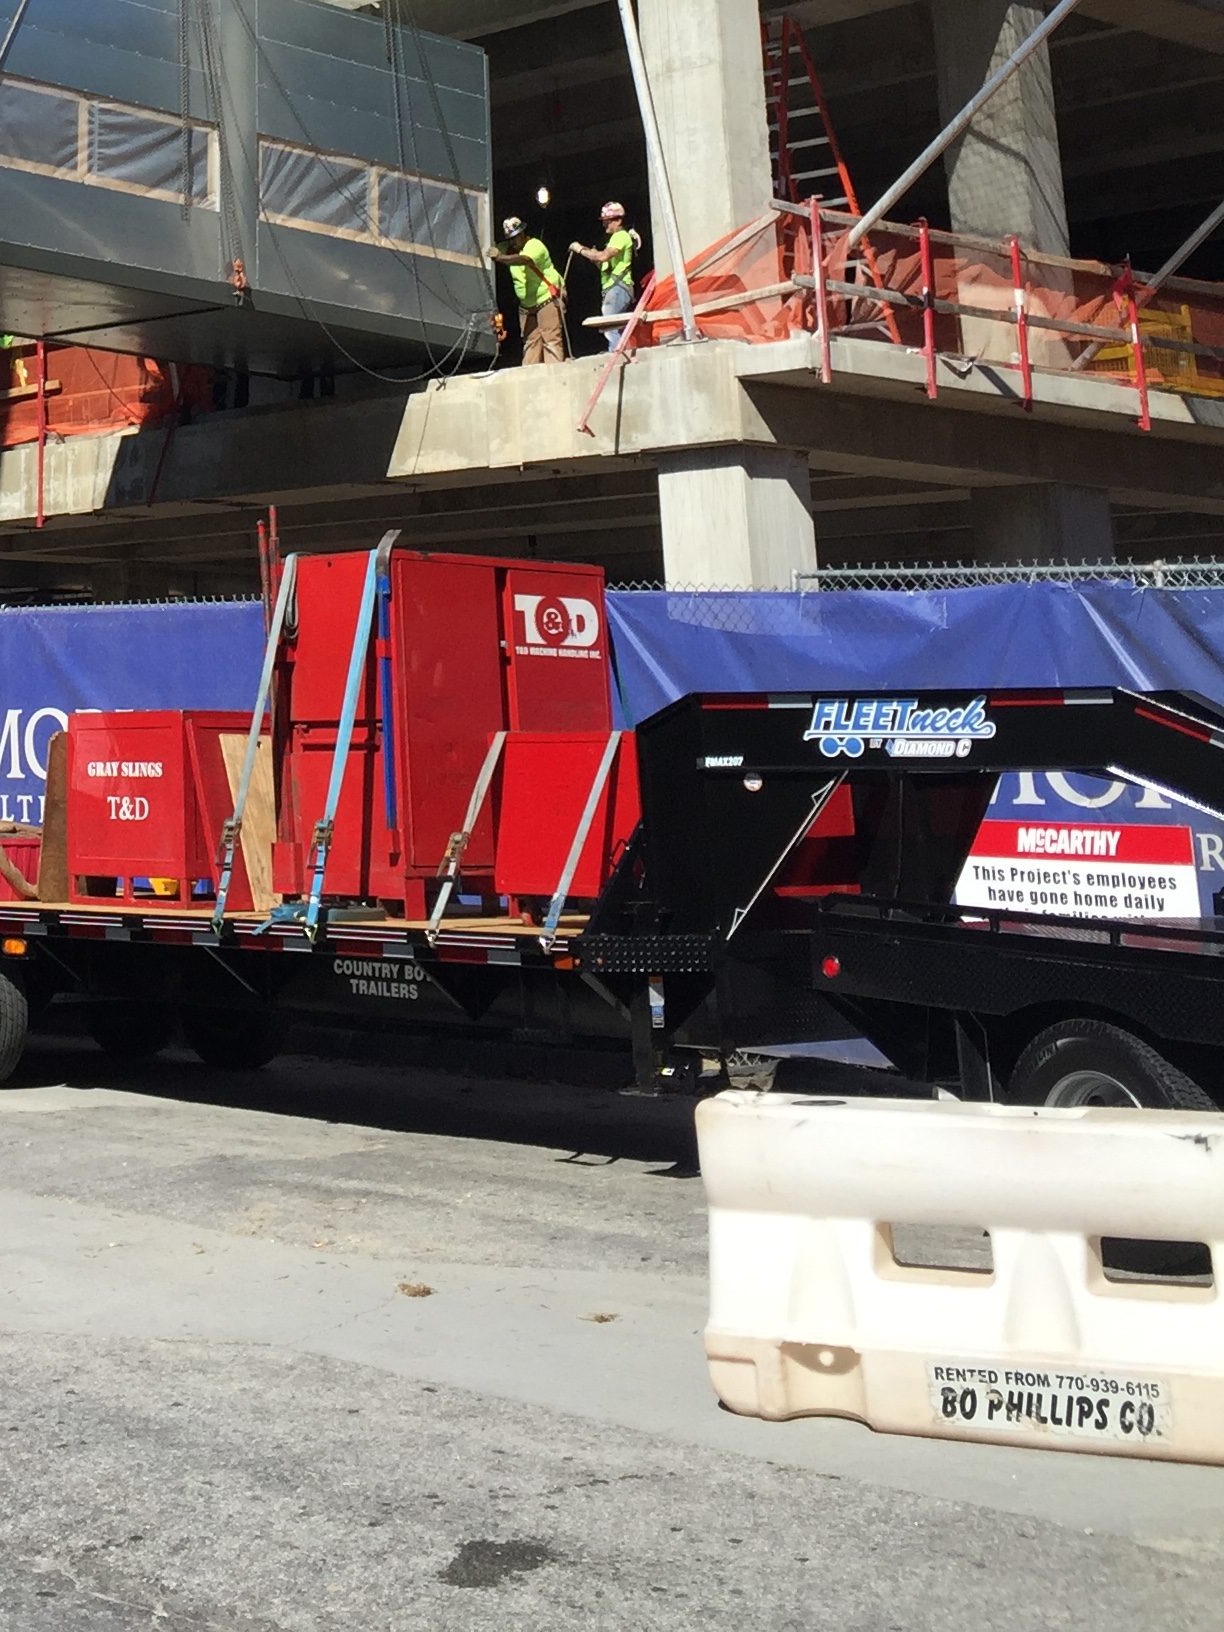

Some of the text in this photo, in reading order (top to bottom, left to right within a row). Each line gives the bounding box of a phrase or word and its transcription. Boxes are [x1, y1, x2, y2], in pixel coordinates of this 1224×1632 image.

[513, 593, 599, 647] T&D
[956, 739, 972, 757] C
[87, 760, 163, 778] GRAY SLINGS
[107, 795, 149, 821] T&D
[973, 865, 1178, 891] This Project's employees
[988, 886, 1025, 903] have
[1029, 890, 1069, 906] gone
[1073, 890, 1119, 909] home
[1123, 893, 1166, 913] daily
[333, 959, 401, 979] COUNTRY
[349, 978, 419, 1000] TRAILERS
[934, 1367, 1160, 1398] RENTED FROM 770-939-6115
[941, 1386, 1163, 1436] BO PHILLIPS CO.
